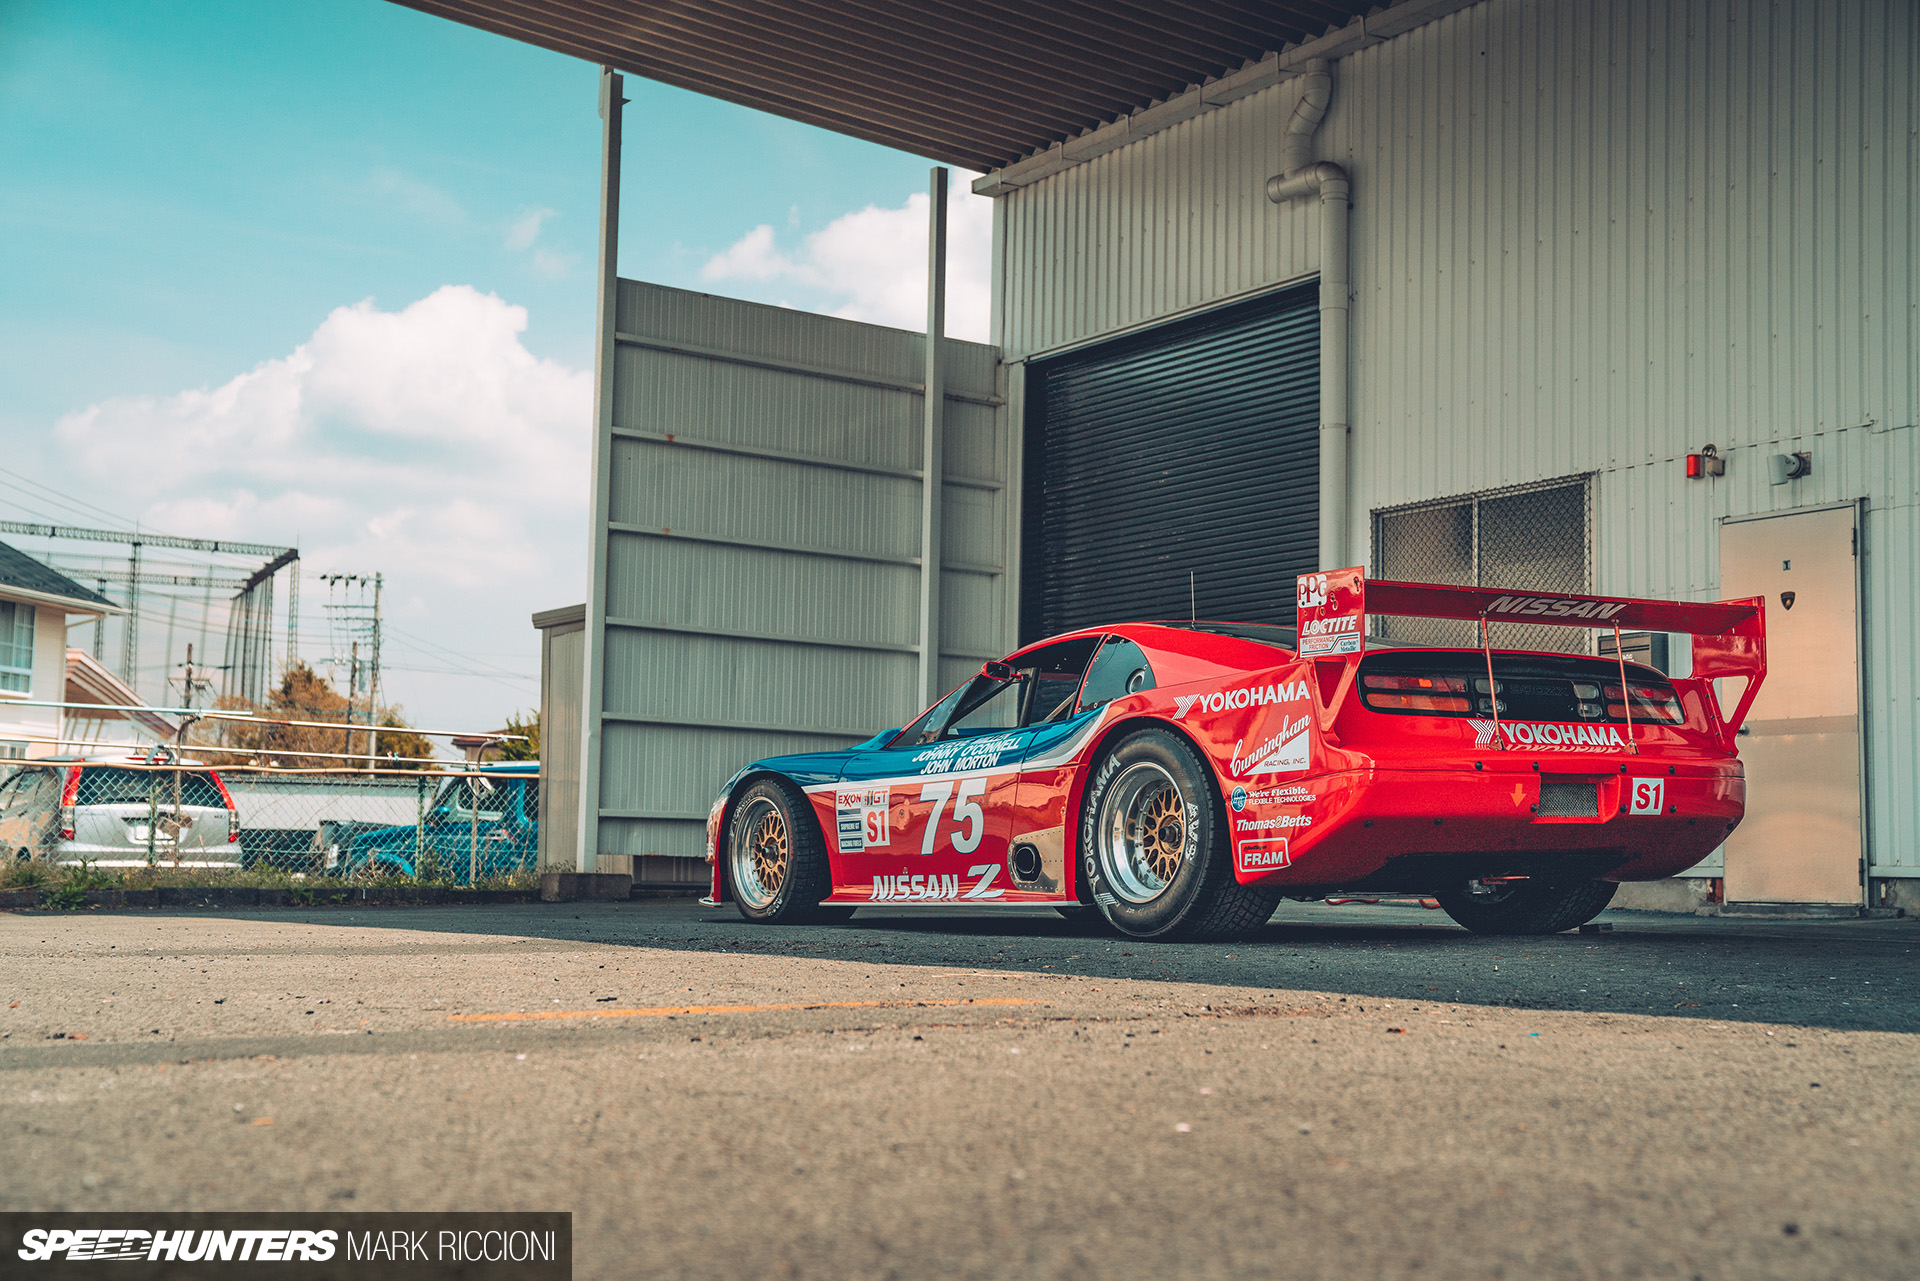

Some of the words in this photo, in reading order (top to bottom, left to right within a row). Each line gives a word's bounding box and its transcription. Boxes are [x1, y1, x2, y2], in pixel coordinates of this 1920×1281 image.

[1487, 595, 1627, 620] NISSAN
[1301, 615, 1358, 636] LOCTITE
[1302, 636, 1335, 645] PERFORMANCE
[1199, 680, 1311, 713] YOKOHAMA
[1229, 714, 1311, 777] Cunningham
[1499, 722, 1626, 747] YOKOHAMA
[912, 746, 963, 762] JOHNNY
[961, 736, 1022, 757] O'CONNELL
[920, 759, 954, 774] JOHN
[953, 752, 1002, 772] MORTON
[838, 793, 862, 807] EXXON
[874, 790, 888, 803] GT
[1248, 797, 1273, 805] FLEXIBLE
[1274, 794, 1316, 803] TECHNOLOGIES
[1635, 783, 1661, 810] S1
[867, 810, 886, 843] S1
[919, 777, 988, 855] 75
[1244, 851, 1284, 866] FRAM
[868, 874, 959, 900] NISSAN
